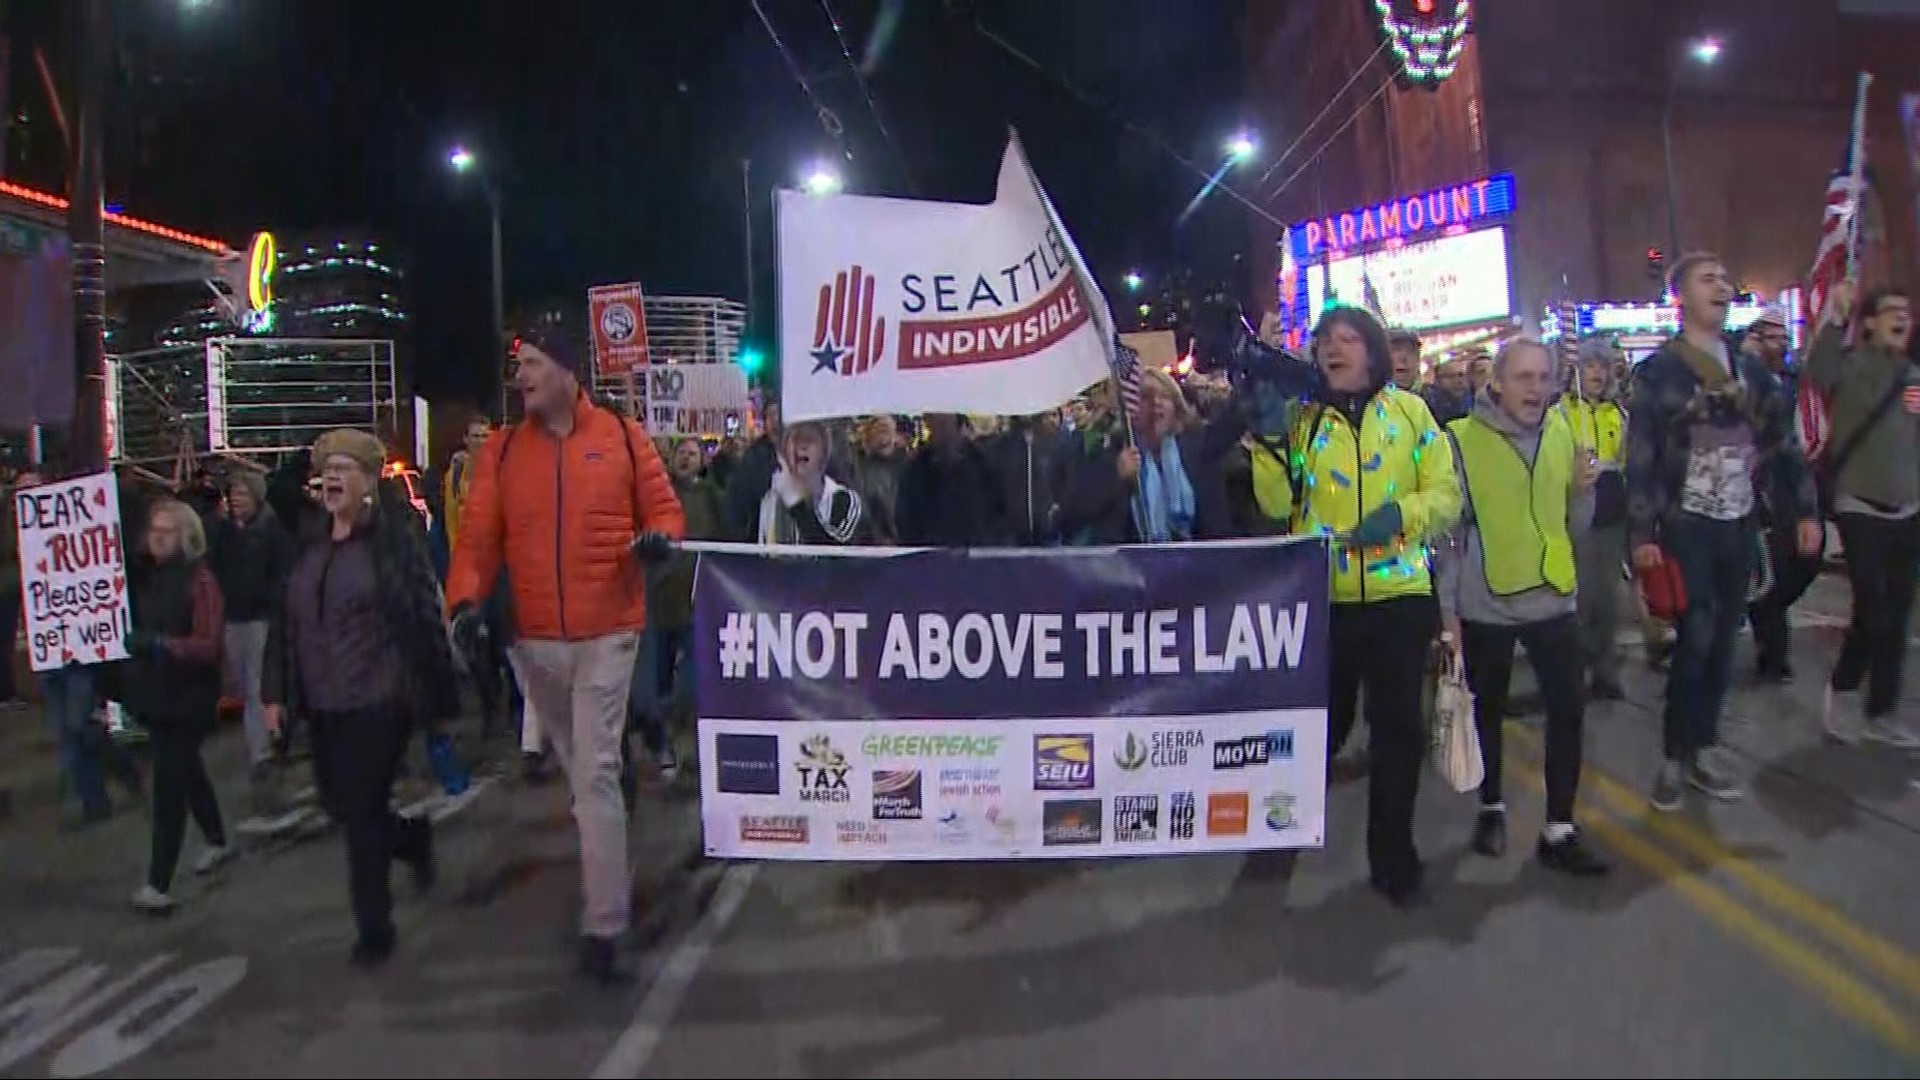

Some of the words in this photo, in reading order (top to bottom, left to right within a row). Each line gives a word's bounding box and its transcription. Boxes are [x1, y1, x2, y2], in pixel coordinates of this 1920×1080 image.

[1306, 180, 1490, 254] PARAMOUNT
[901, 228, 1070, 313] SEATTLE
[912, 286, 1081, 358] INDIVISIBLE
[651, 368, 684, 394] NO
[19, 486, 92, 529] DEAR
[29, 578, 111, 610] Please
[35, 618, 70, 663] get
[719, 611, 868, 679] #NOT
[878, 612, 1064, 679] ABOVE
[1075, 608, 1180, 677] THE
[1193, 601, 1309, 673] LAW
[861, 734, 1004, 761] GREENPEACE
[1151, 730, 1205, 748] SIERRA
[1151, 748, 1189, 767] CLUB
[797, 767, 849, 789] TAX
[1038, 763, 1090, 780] SEIU
[799, 788, 850, 803] MARCH
[1114, 796, 1157, 812] STAND
[1115, 811, 1139, 830] UP
[1171, 805, 1195, 822] NO
